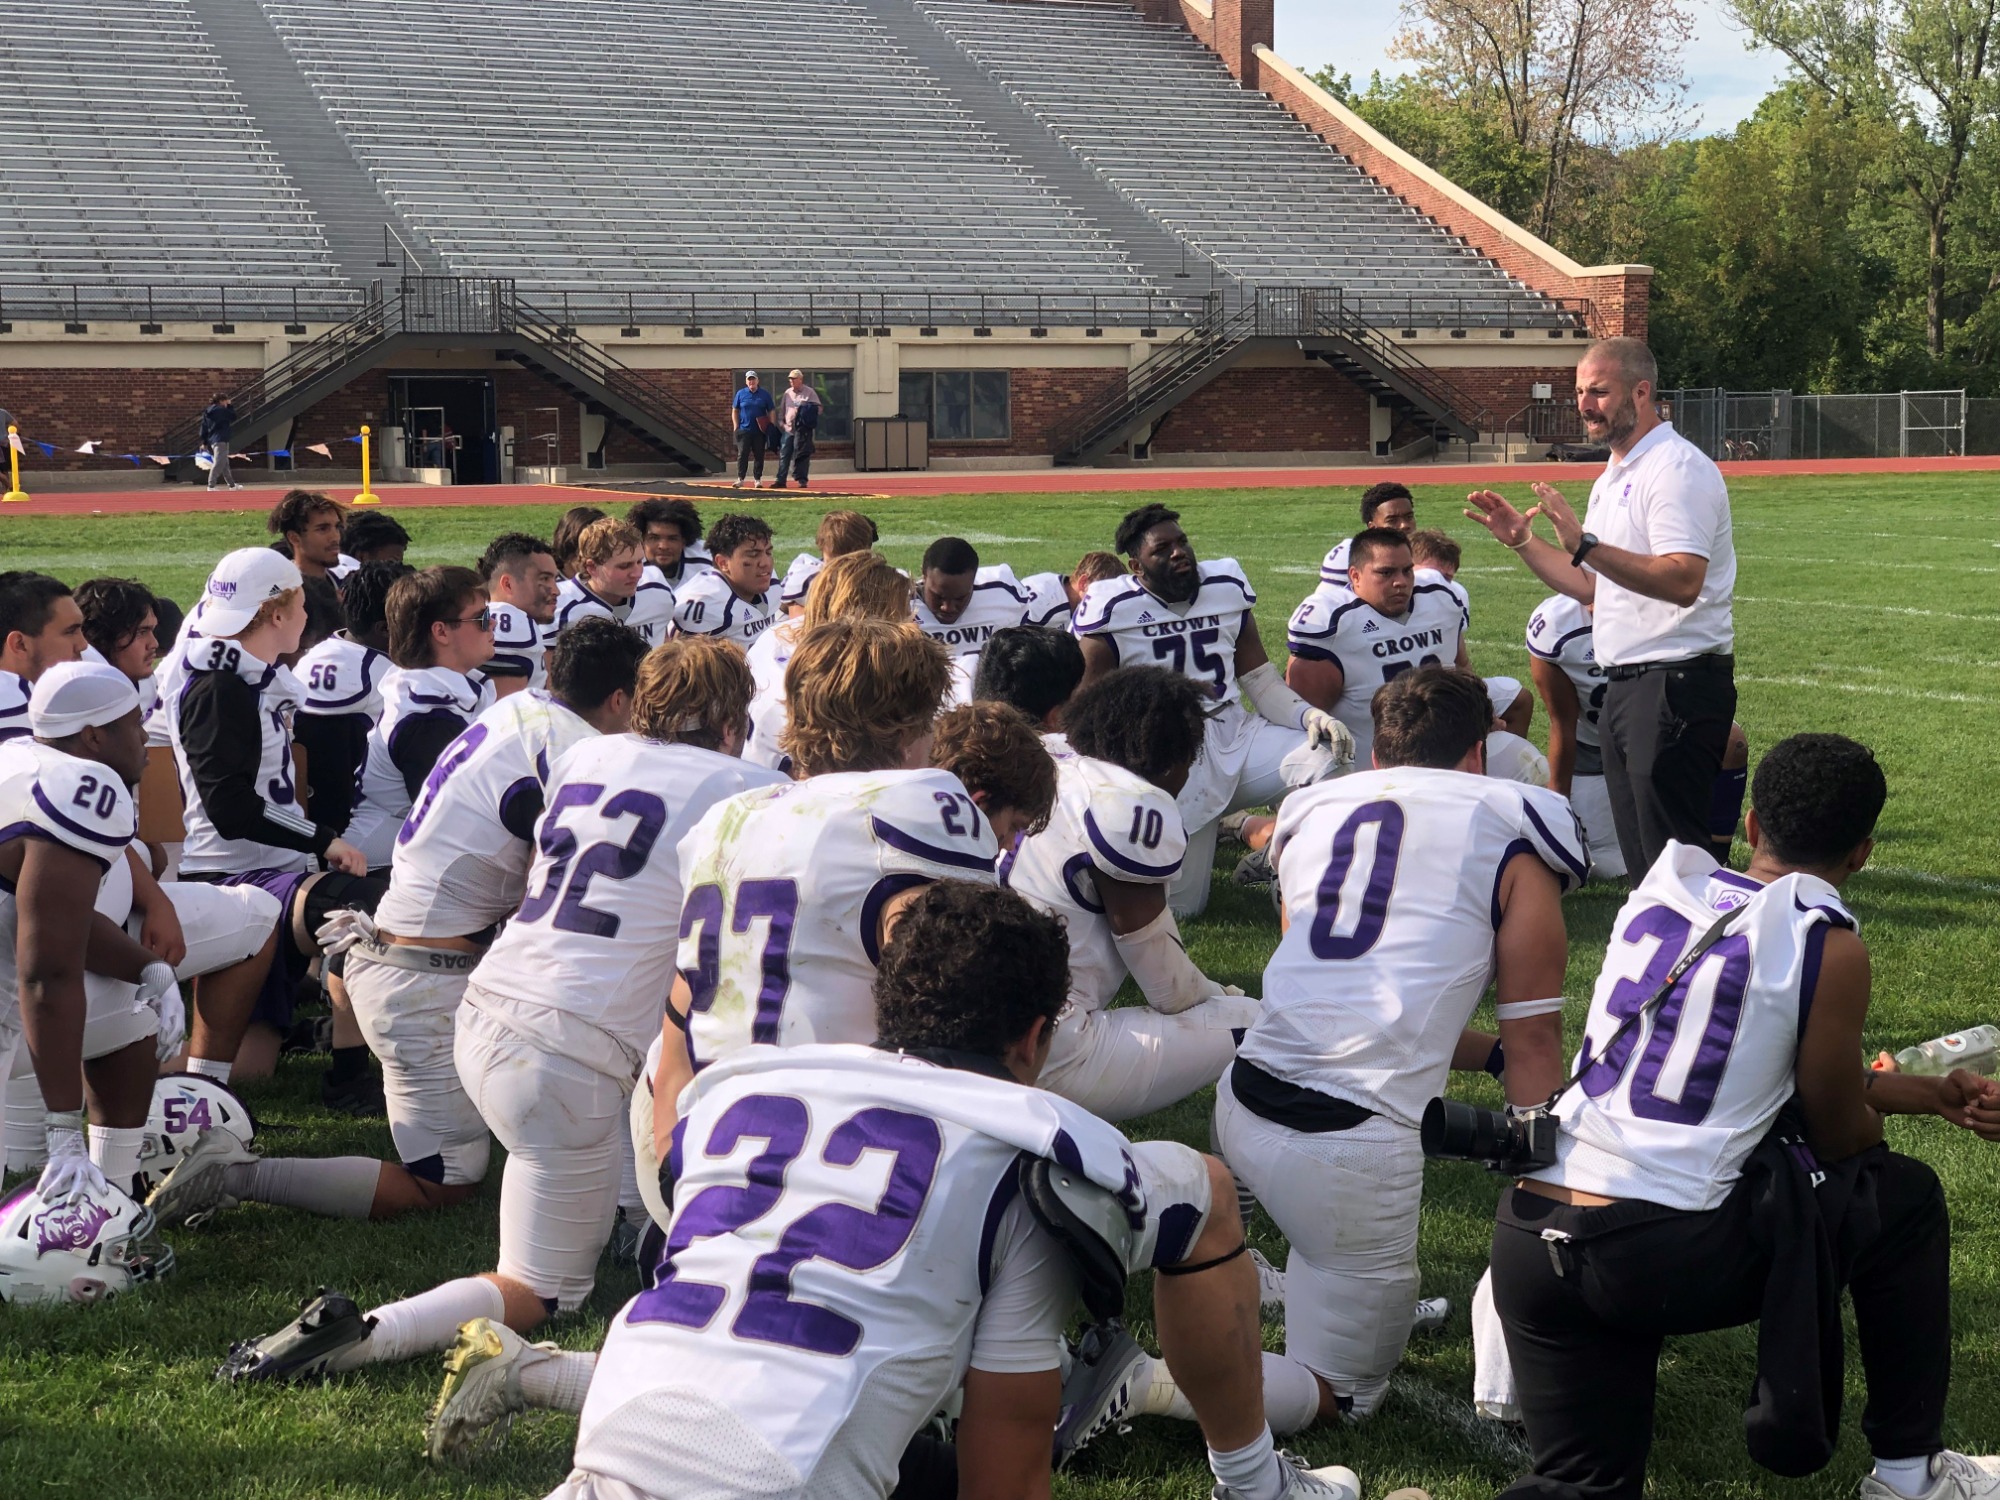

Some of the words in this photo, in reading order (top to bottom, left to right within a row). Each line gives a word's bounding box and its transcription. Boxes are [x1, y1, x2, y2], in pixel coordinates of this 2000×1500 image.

[684, 599, 705, 624] 70
[1143, 615, 1220, 637] CROWN
[922, 625, 994, 644] ROWN
[1372, 629, 1443, 658] CROWN
[207, 640, 241, 674] 39
[308, 664, 337, 691] 56
[72, 775, 117, 819] 20
[934, 791, 980, 841] 27
[1129, 805, 1164, 849] 10
[515, 783, 668, 939] 52
[1309, 799, 1404, 960] 0
[1580, 904, 1753, 1127] 30
[164, 1097, 212, 1134] 54
[624, 1093, 946, 1357] 22
